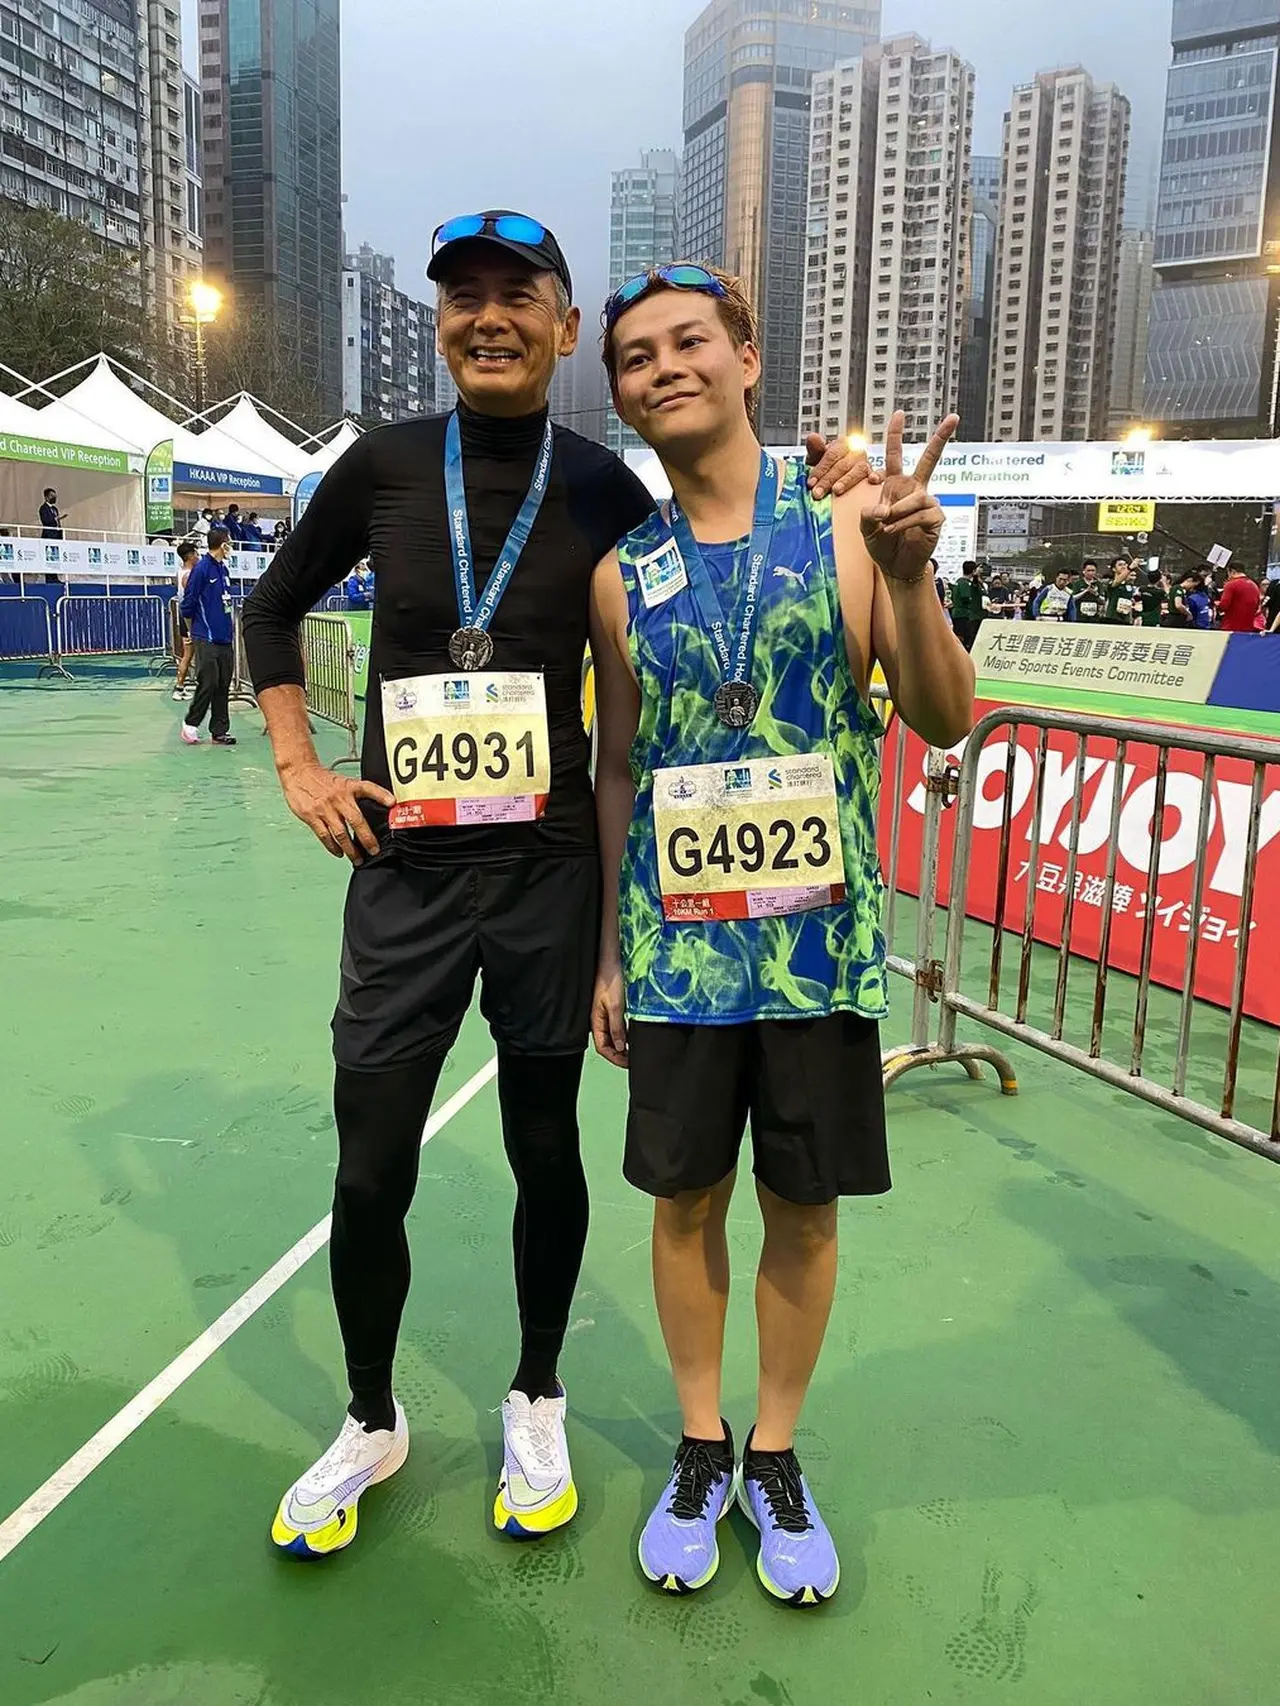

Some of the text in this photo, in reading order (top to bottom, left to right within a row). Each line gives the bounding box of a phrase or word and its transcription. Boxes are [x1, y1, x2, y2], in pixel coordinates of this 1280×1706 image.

[9, 439, 58, 458] Chartered
[61, 447, 75, 460] VIP
[79, 450, 121, 469] Reception
[534, 448, 550, 491] Standard
[869, 456, 884, 467] 25
[189, 468, 261, 489] HKAAA VIP Reception
[931, 471, 1030, 484] ong Marathon
[453, 509, 467, 557] Standard
[459, 559, 473, 613] Chartered
[485, 561, 511, 606] Standard
[746, 554, 763, 602] Standard
[738, 605, 755, 660] Chartered
[989, 633, 1195, 667] 大型體育活動事務委員會
[983, 656, 1184, 687] Major Sports Events Committee
[393, 730, 535, 784] G4931
[668, 816, 831, 877] G4923
